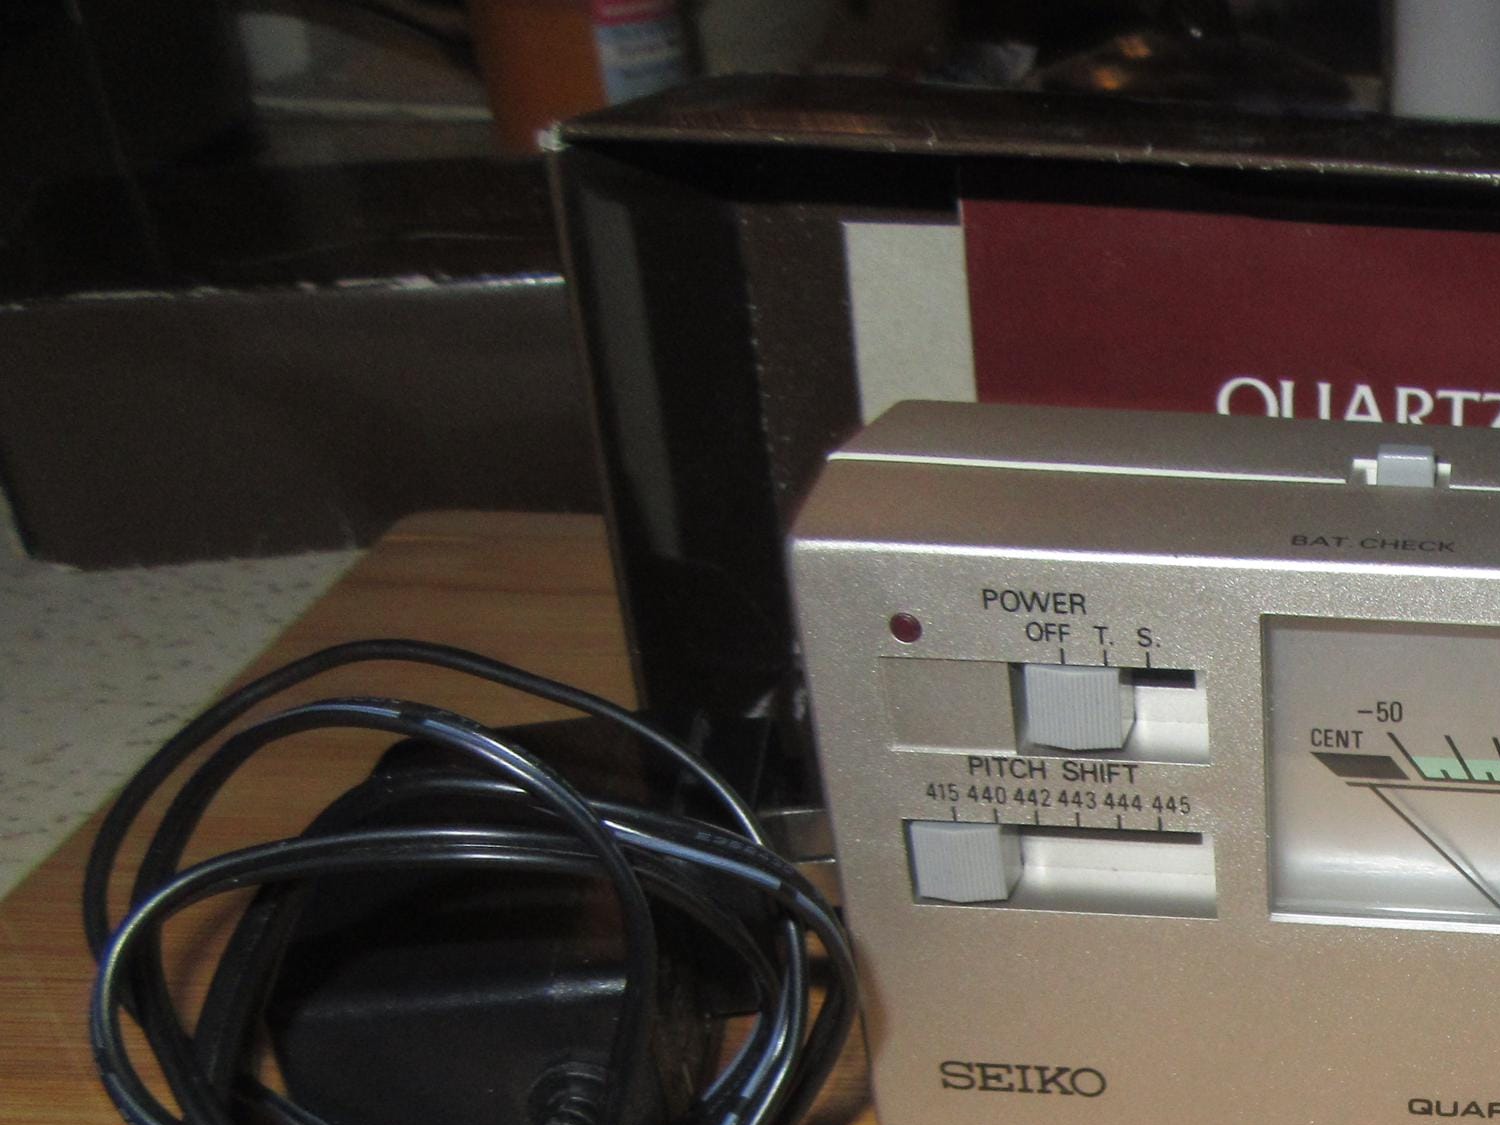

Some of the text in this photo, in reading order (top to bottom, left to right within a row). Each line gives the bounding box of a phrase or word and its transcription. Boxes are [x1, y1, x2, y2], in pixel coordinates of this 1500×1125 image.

[1360, 537, 1456, 553] CHECK
[981, 588, 1088, 615] POWER
[1025, 621, 1071, 644] OFF
[1310, 727, 1364, 749] CENT
[967, 756, 1139, 784] PITCH SHIFT
[925, 783, 1191, 815] 415 440 442 443 444 445
[939, 1060, 1107, 1098] SEIKO
